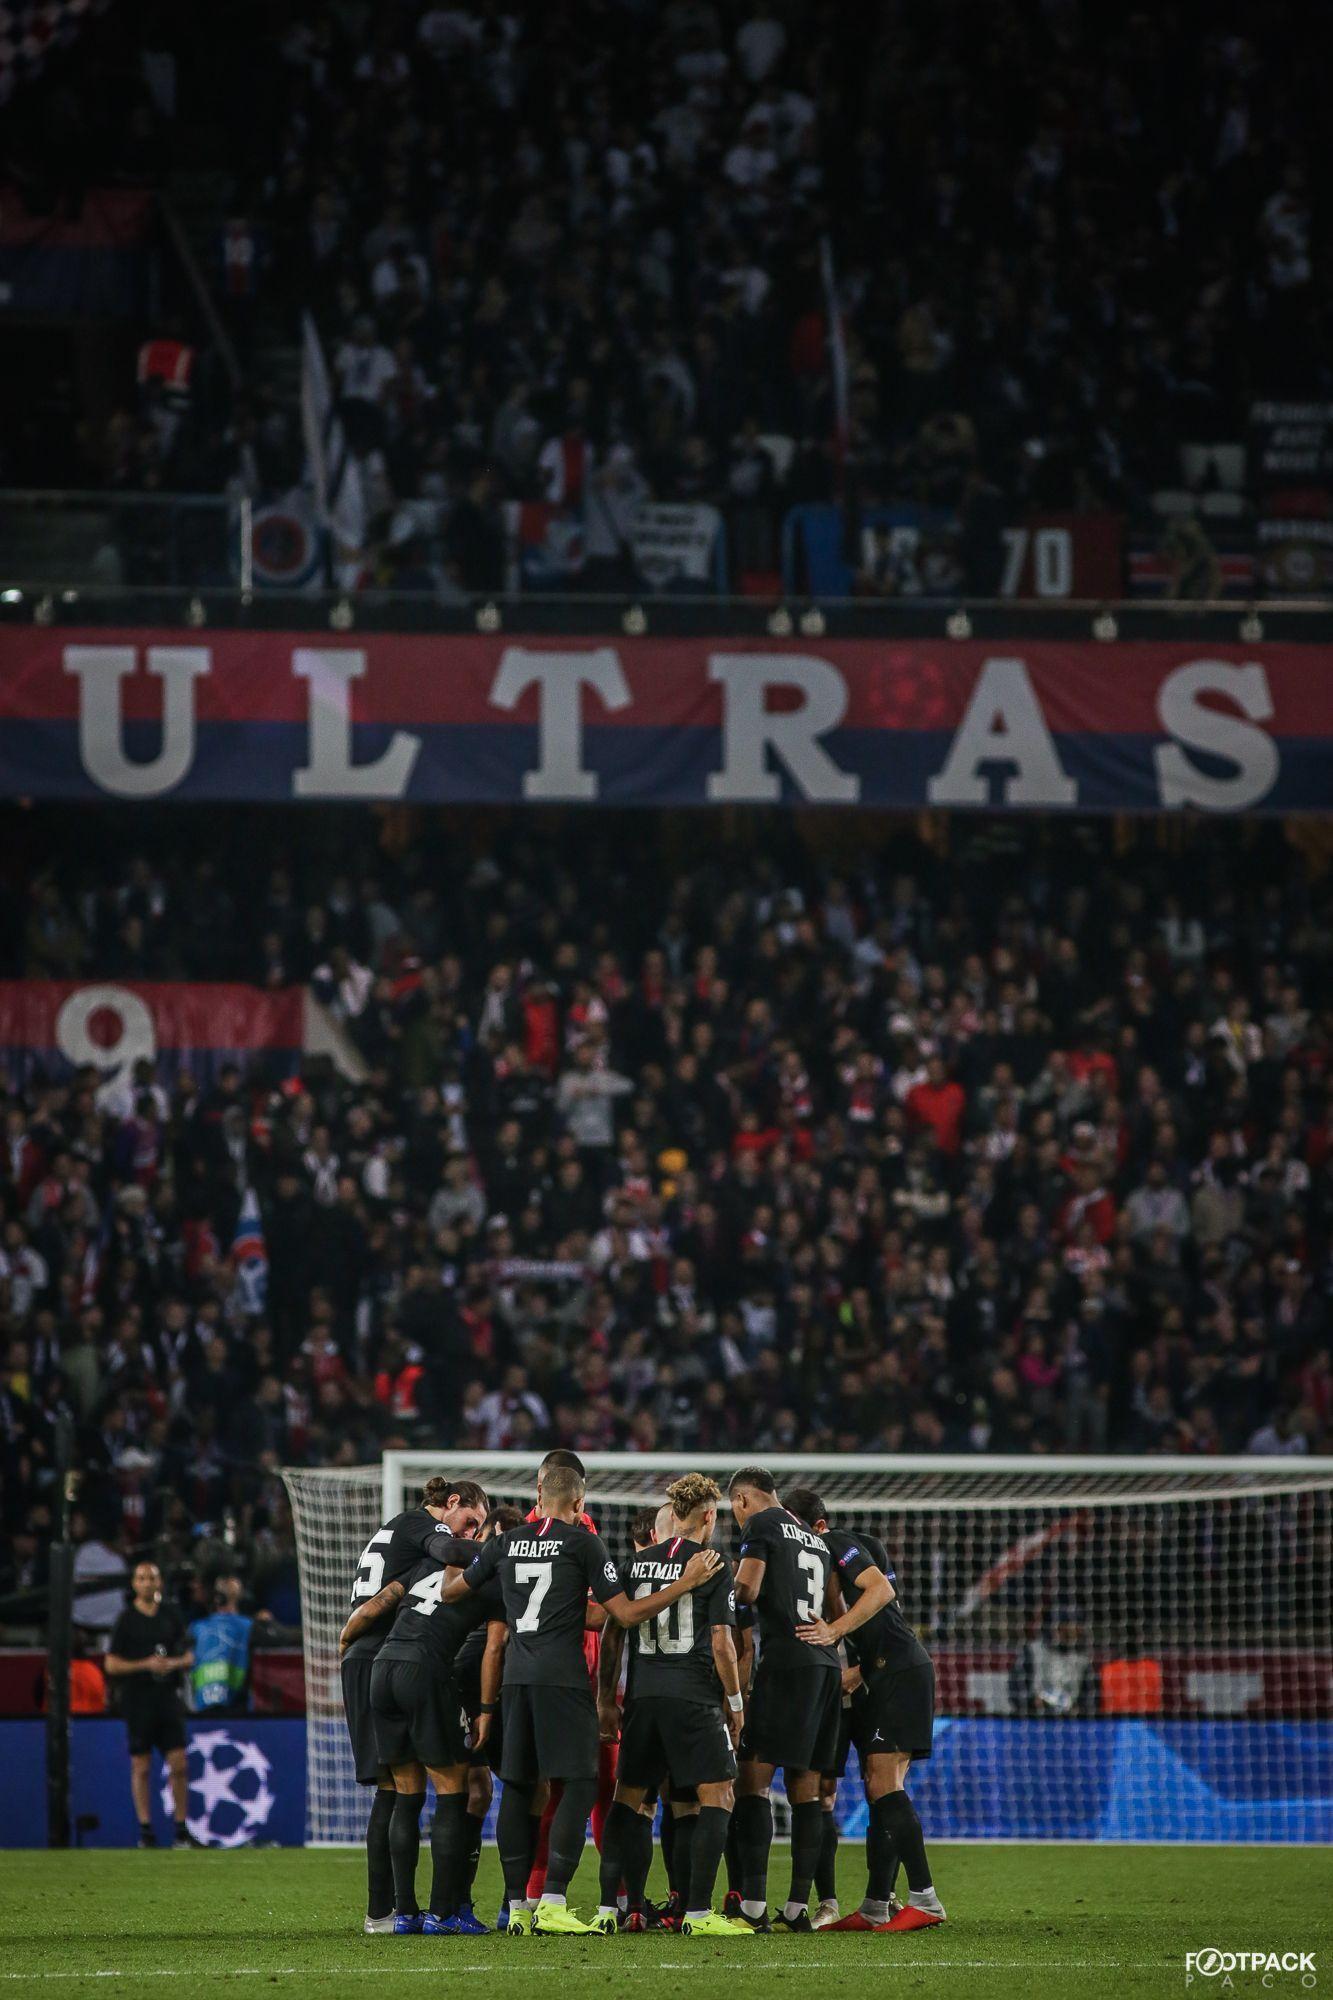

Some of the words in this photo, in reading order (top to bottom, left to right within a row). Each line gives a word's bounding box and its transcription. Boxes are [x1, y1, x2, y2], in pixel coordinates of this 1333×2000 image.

[1000, 526, 1073, 598] 70
[62, 645, 1279, 812] ULTRAS
[350, 1528, 395, 1604] 5
[507, 1540, 564, 1558] MBAPPE
[630, 1561, 683, 1581] NEYMAR
[408, 1569, 446, 1616] 4
[515, 1561, 553, 1634] 7
[634, 1582, 695, 1655] 10
[797, 1549, 825, 1624] 3
